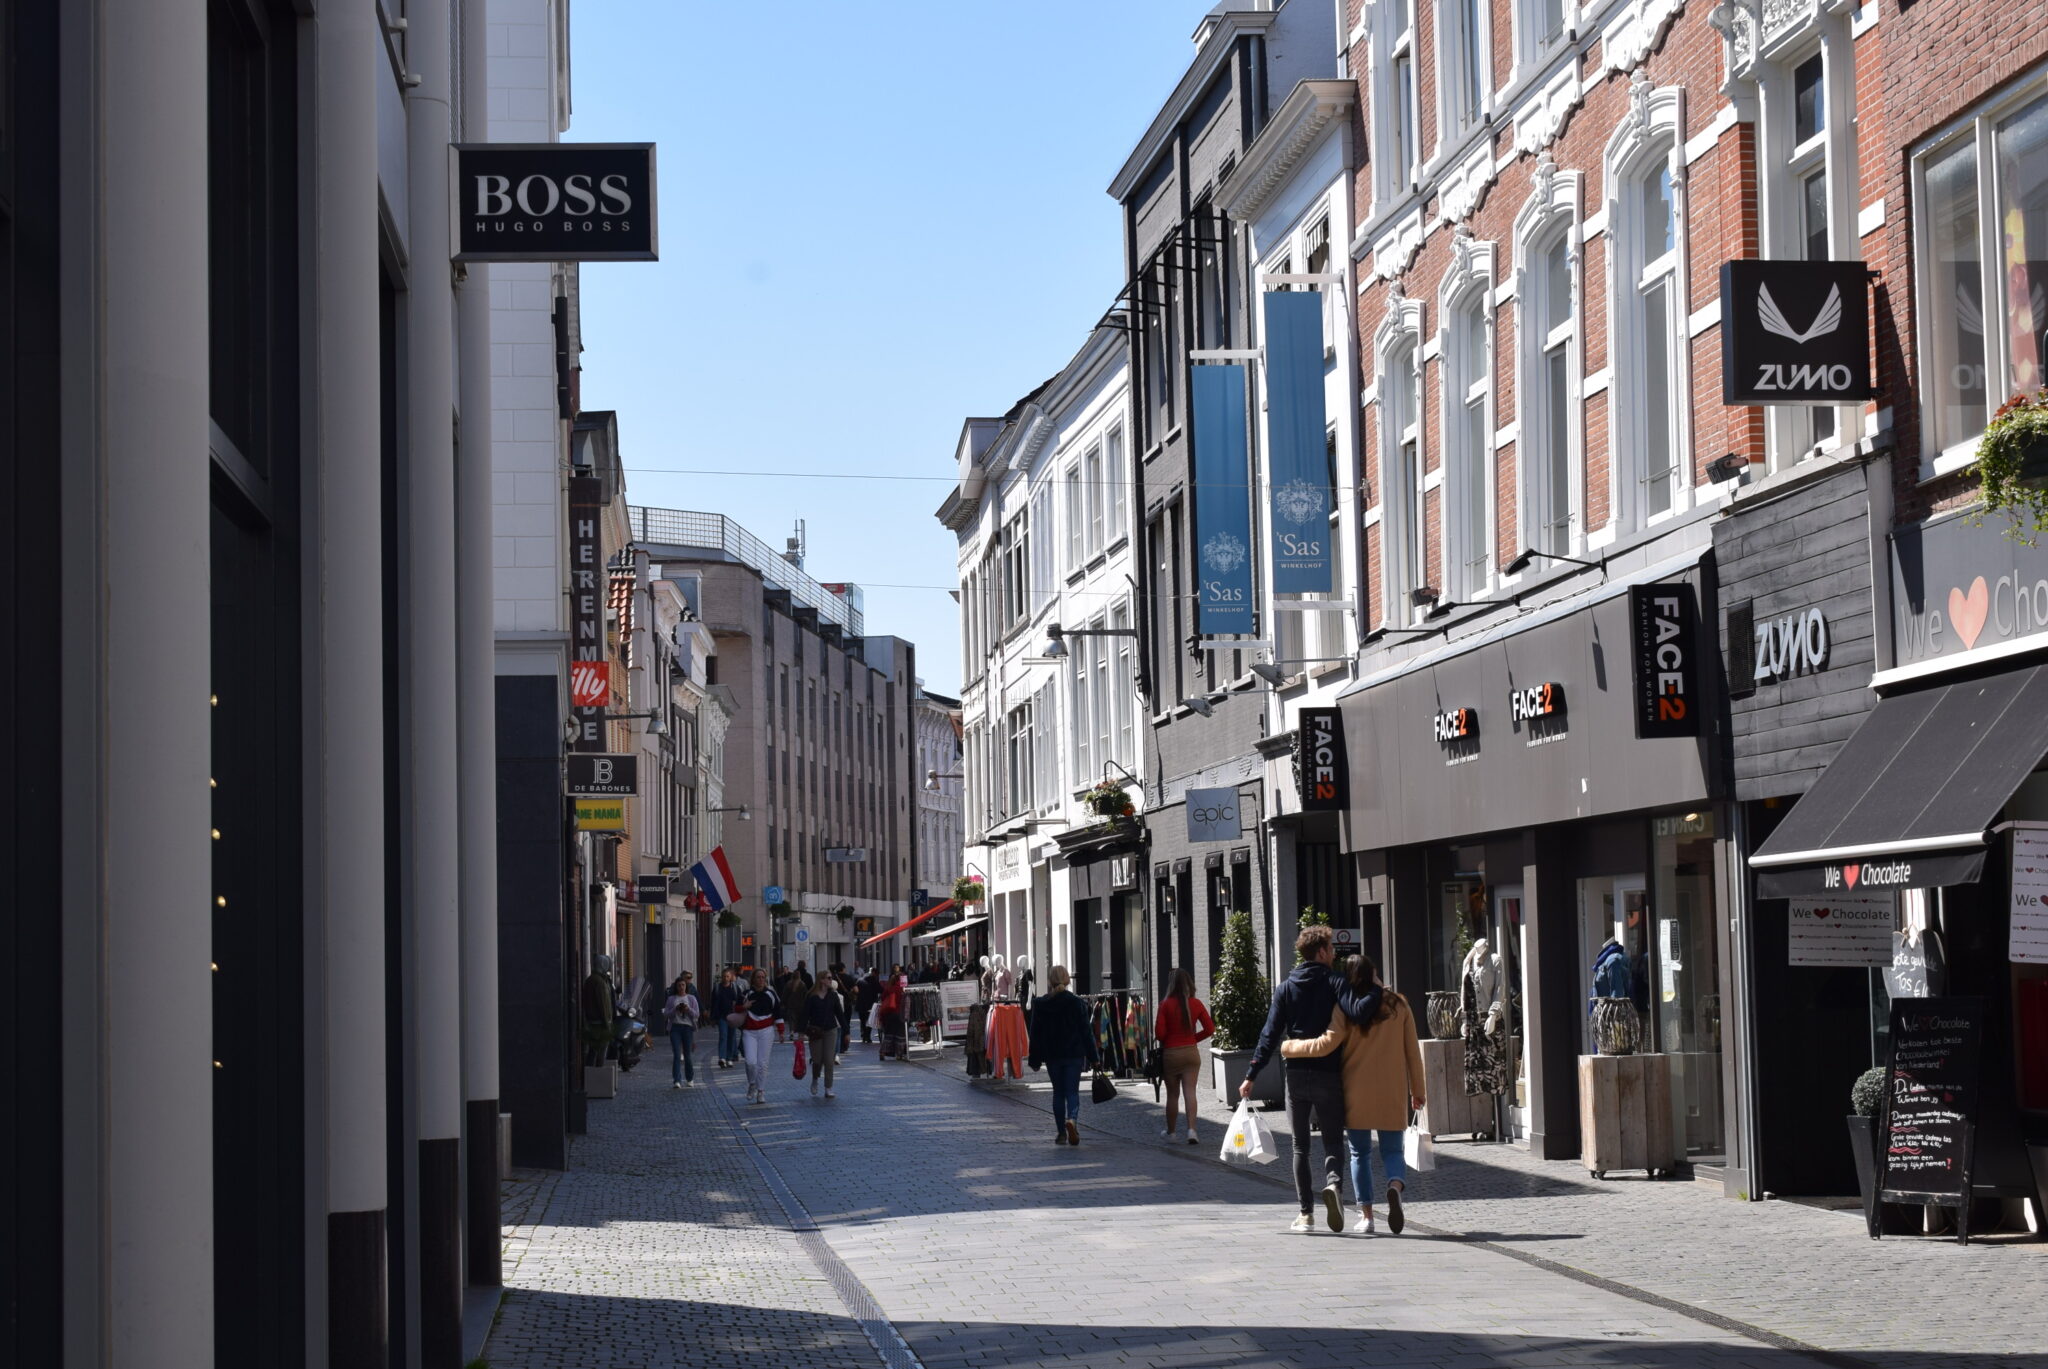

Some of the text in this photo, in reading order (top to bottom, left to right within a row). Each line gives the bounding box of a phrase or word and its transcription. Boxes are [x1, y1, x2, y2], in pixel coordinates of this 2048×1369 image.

[474, 174, 632, 217] BOSS
[476, 221, 630, 232] HUGO BOSS
[1752, 364, 1852, 391] ZUMO
[578, 519, 597, 741] HERENME
[1641, 598, 1649, 646] FASHION
[1899, 598, 1944, 660] We
[1654, 596, 1686, 721] FACE2
[1753, 607, 1825, 680] ZUMO
[572, 667, 607, 702] illy
[1512, 682, 1553, 721] FACE2
[1434, 707, 1467, 742] FACE2
[1314, 715, 1336, 800] FACE2
[575, 808, 621, 820] AME MANIA
[1193, 804, 1234, 825] epic
[1825, 861, 1911, 888] We Chocolate
[1792, 908, 1890, 920] We Chocolate
[2015, 894, 2038, 906] We
